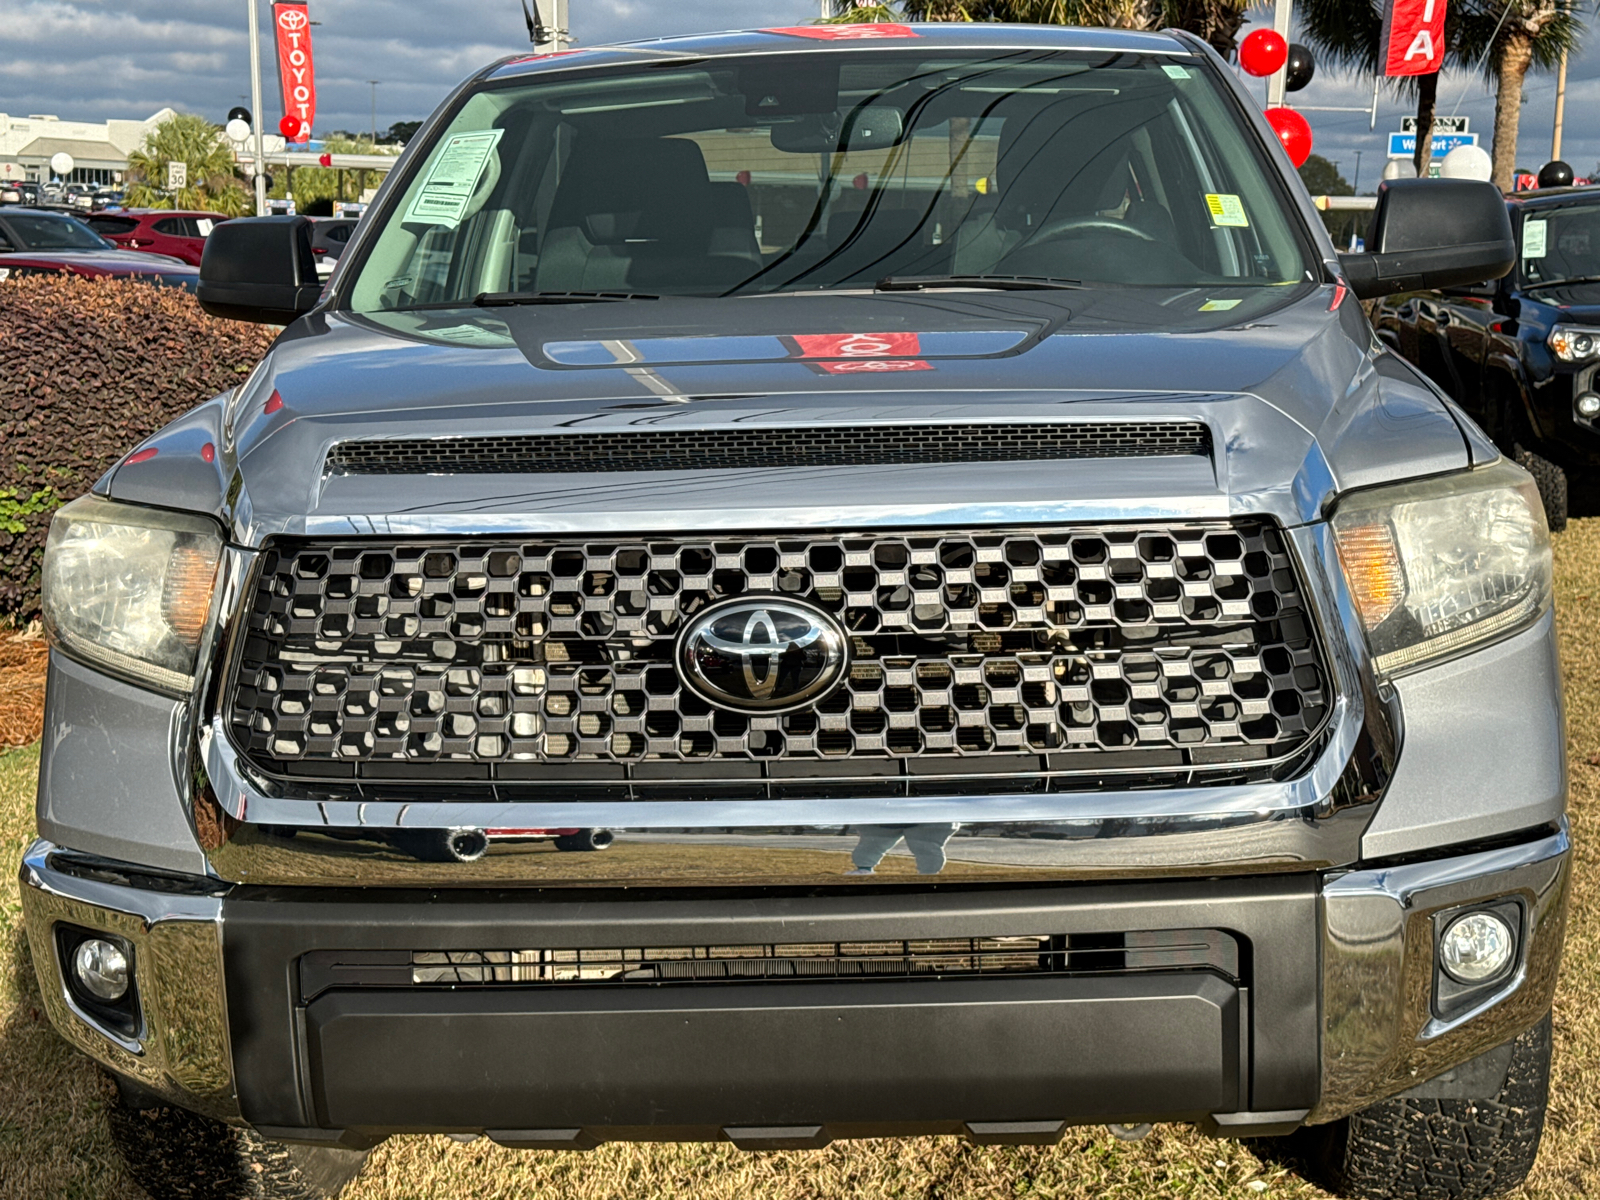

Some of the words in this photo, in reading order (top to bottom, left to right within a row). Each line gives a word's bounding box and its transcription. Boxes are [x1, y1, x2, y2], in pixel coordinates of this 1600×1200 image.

[288, 32, 310, 137] TOYOTA
[1405, 118, 1464, 126] AANY
[1402, 139, 1447, 150] Waart
[171, 174, 184, 185] 30
